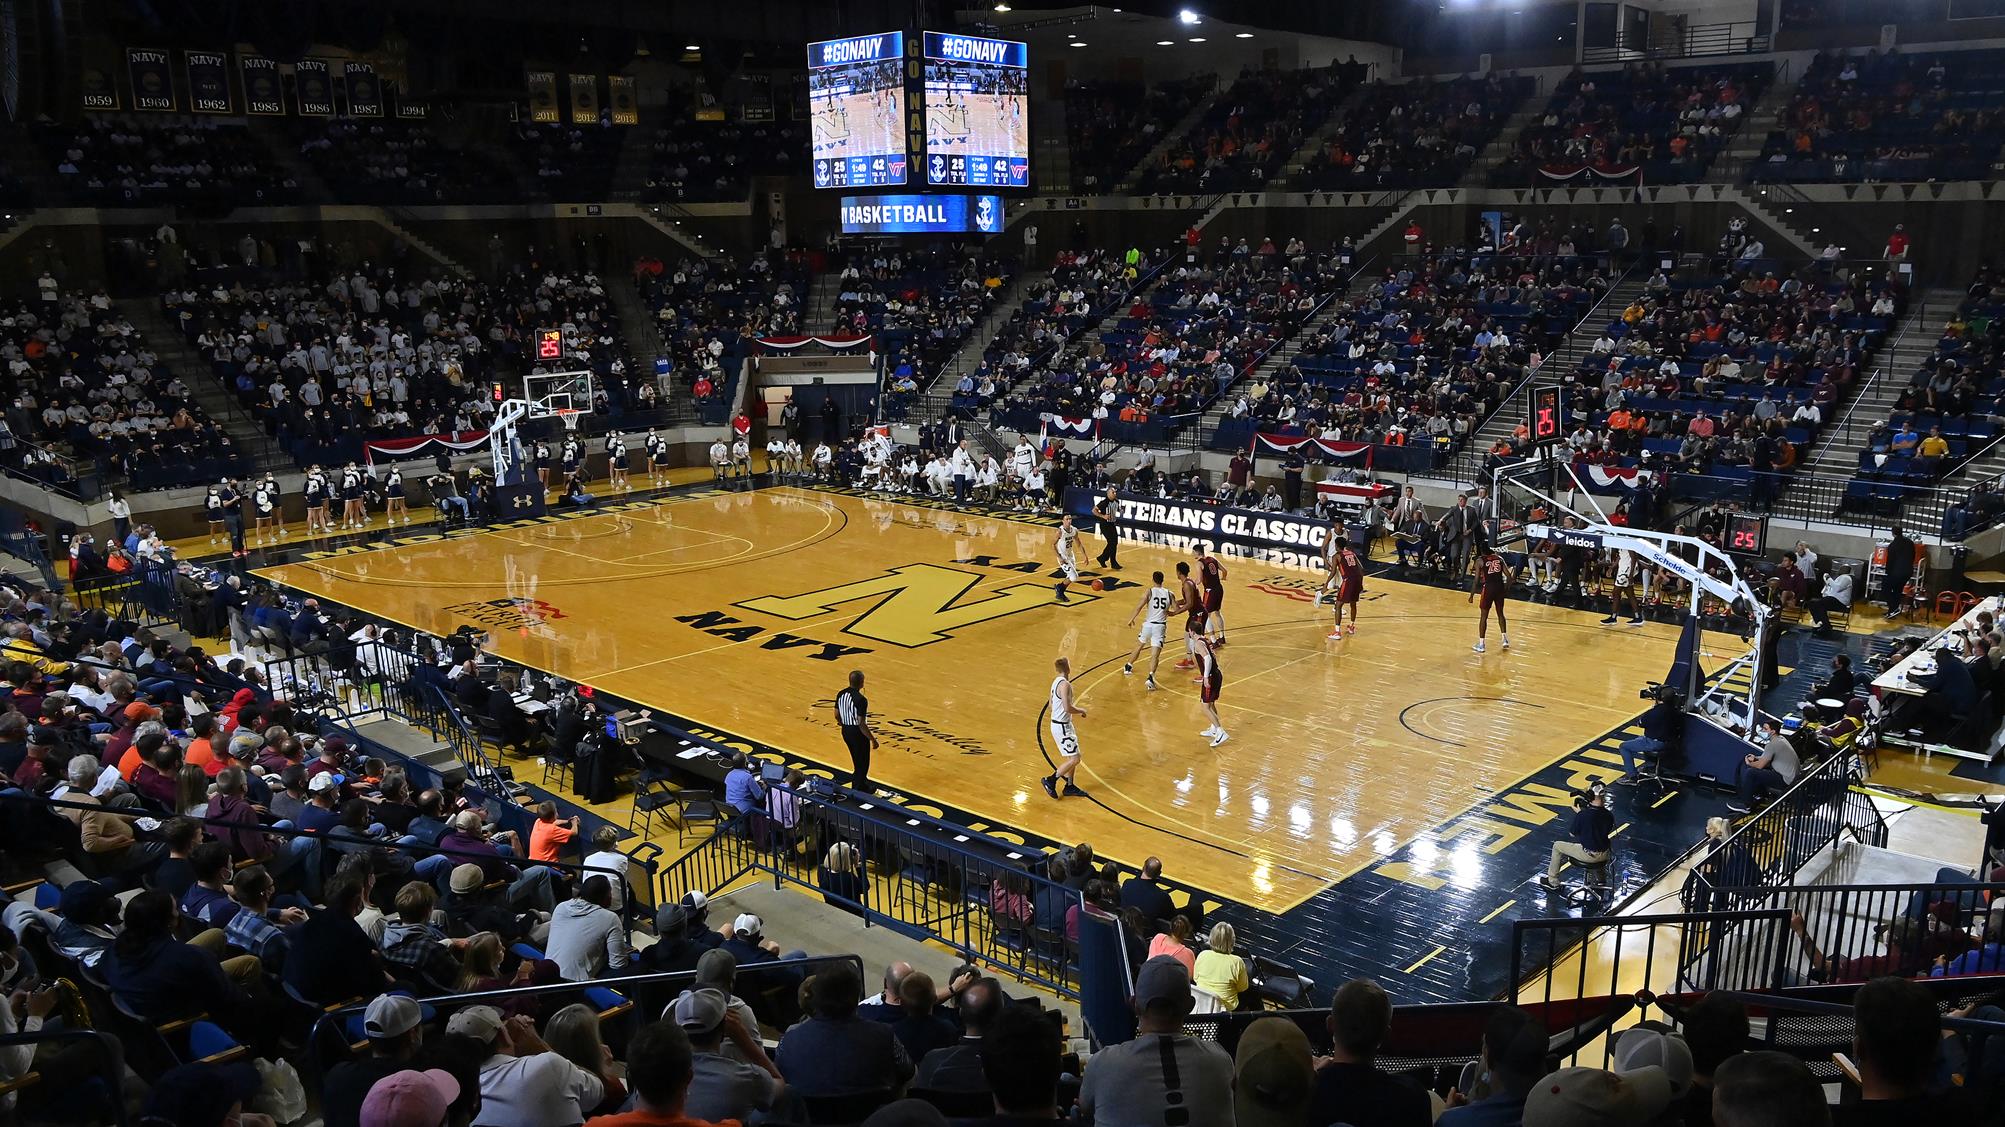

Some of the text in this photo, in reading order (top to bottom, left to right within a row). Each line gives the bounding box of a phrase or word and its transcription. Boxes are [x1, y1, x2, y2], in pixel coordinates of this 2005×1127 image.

[823, 36, 882, 63] #GONAVY
[942, 37, 1008, 63] #GONAVY
[132, 52, 166, 64] NAVY
[189, 54, 223, 67] NAVY
[244, 58, 277, 70] NAVY
[296, 60, 327, 72] NAVY
[346, 63, 374, 74] NAVY
[83, 95, 113, 106] 1959
[140, 97, 170, 108] 1960
[198, 99, 226, 110] 1962
[252, 101, 279, 112] 1985
[907, 39, 923, 174] GO NAVY
[304, 103, 330, 113] 1986
[353, 104, 378, 115] 1987
[402, 106, 425, 116] 1994
[535, 111, 556, 121] 2011
[576, 113, 597, 123] 2012
[833, 161, 846, 173] 25
[851, 163, 867, 173] 1:49
[872, 159, 885, 171] 42
[951, 158, 965, 170] 25
[971, 162, 988, 172] 1:49
[994, 160, 1007, 172] 42
[849, 204, 947, 224] BASKETBALL
[541, 340, 560, 357] 25
[1537, 408, 1555, 436] 25
[1093, 496, 1327, 547] TERANS CLASSIC
[1565, 535, 1595, 549] leidos
[1734, 530, 1755, 548] 25
[1485, 559, 1501, 575] 25
[1652, 553, 1686, 575] Schelde
[1153, 596, 1167, 610] 35
[672, 610, 875, 661] NAVY
[888, 718, 993, 756] Smalley
